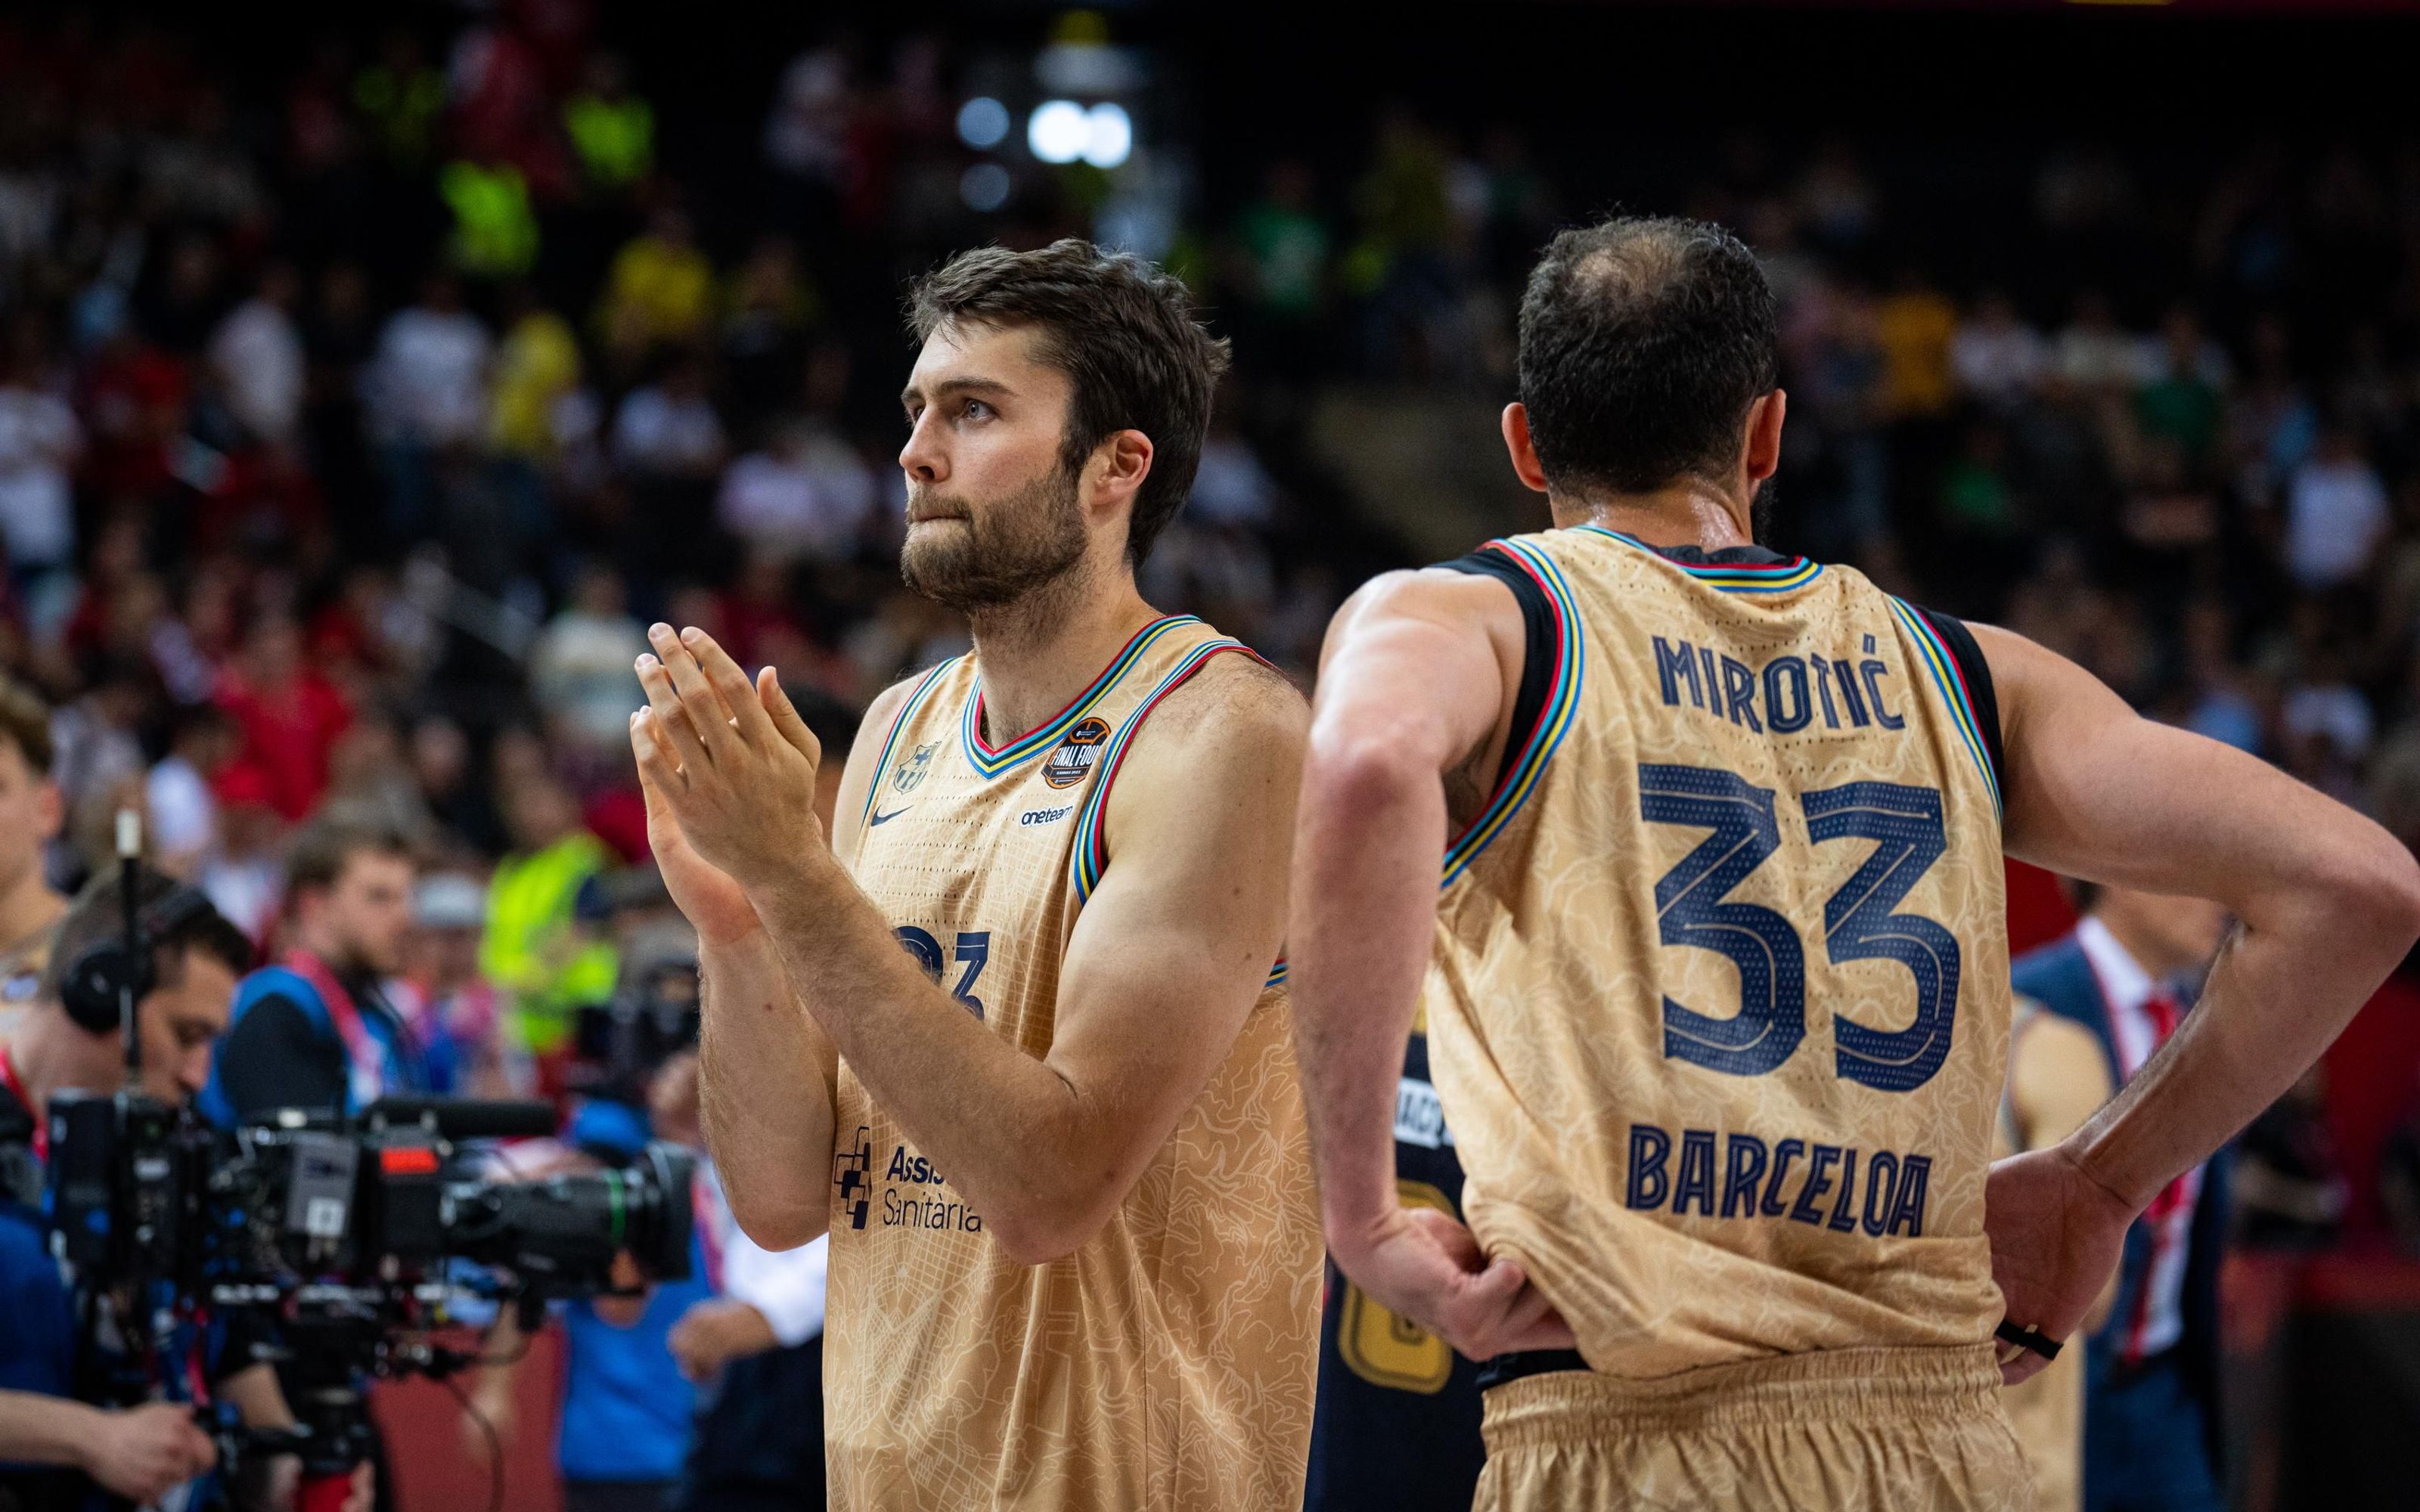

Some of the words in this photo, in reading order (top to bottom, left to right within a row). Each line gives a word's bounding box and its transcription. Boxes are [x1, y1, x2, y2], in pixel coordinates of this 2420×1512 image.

[1652, 634, 1906, 734] MIROTIĆ
[1051, 745, 1078, 767] FINAL
[1074, 745, 1100, 767] FOU
[1022, 806, 1072, 825] oneteam
[1638, 762, 1962, 1093] 33
[883, 1188, 982, 1232] Sanitària
